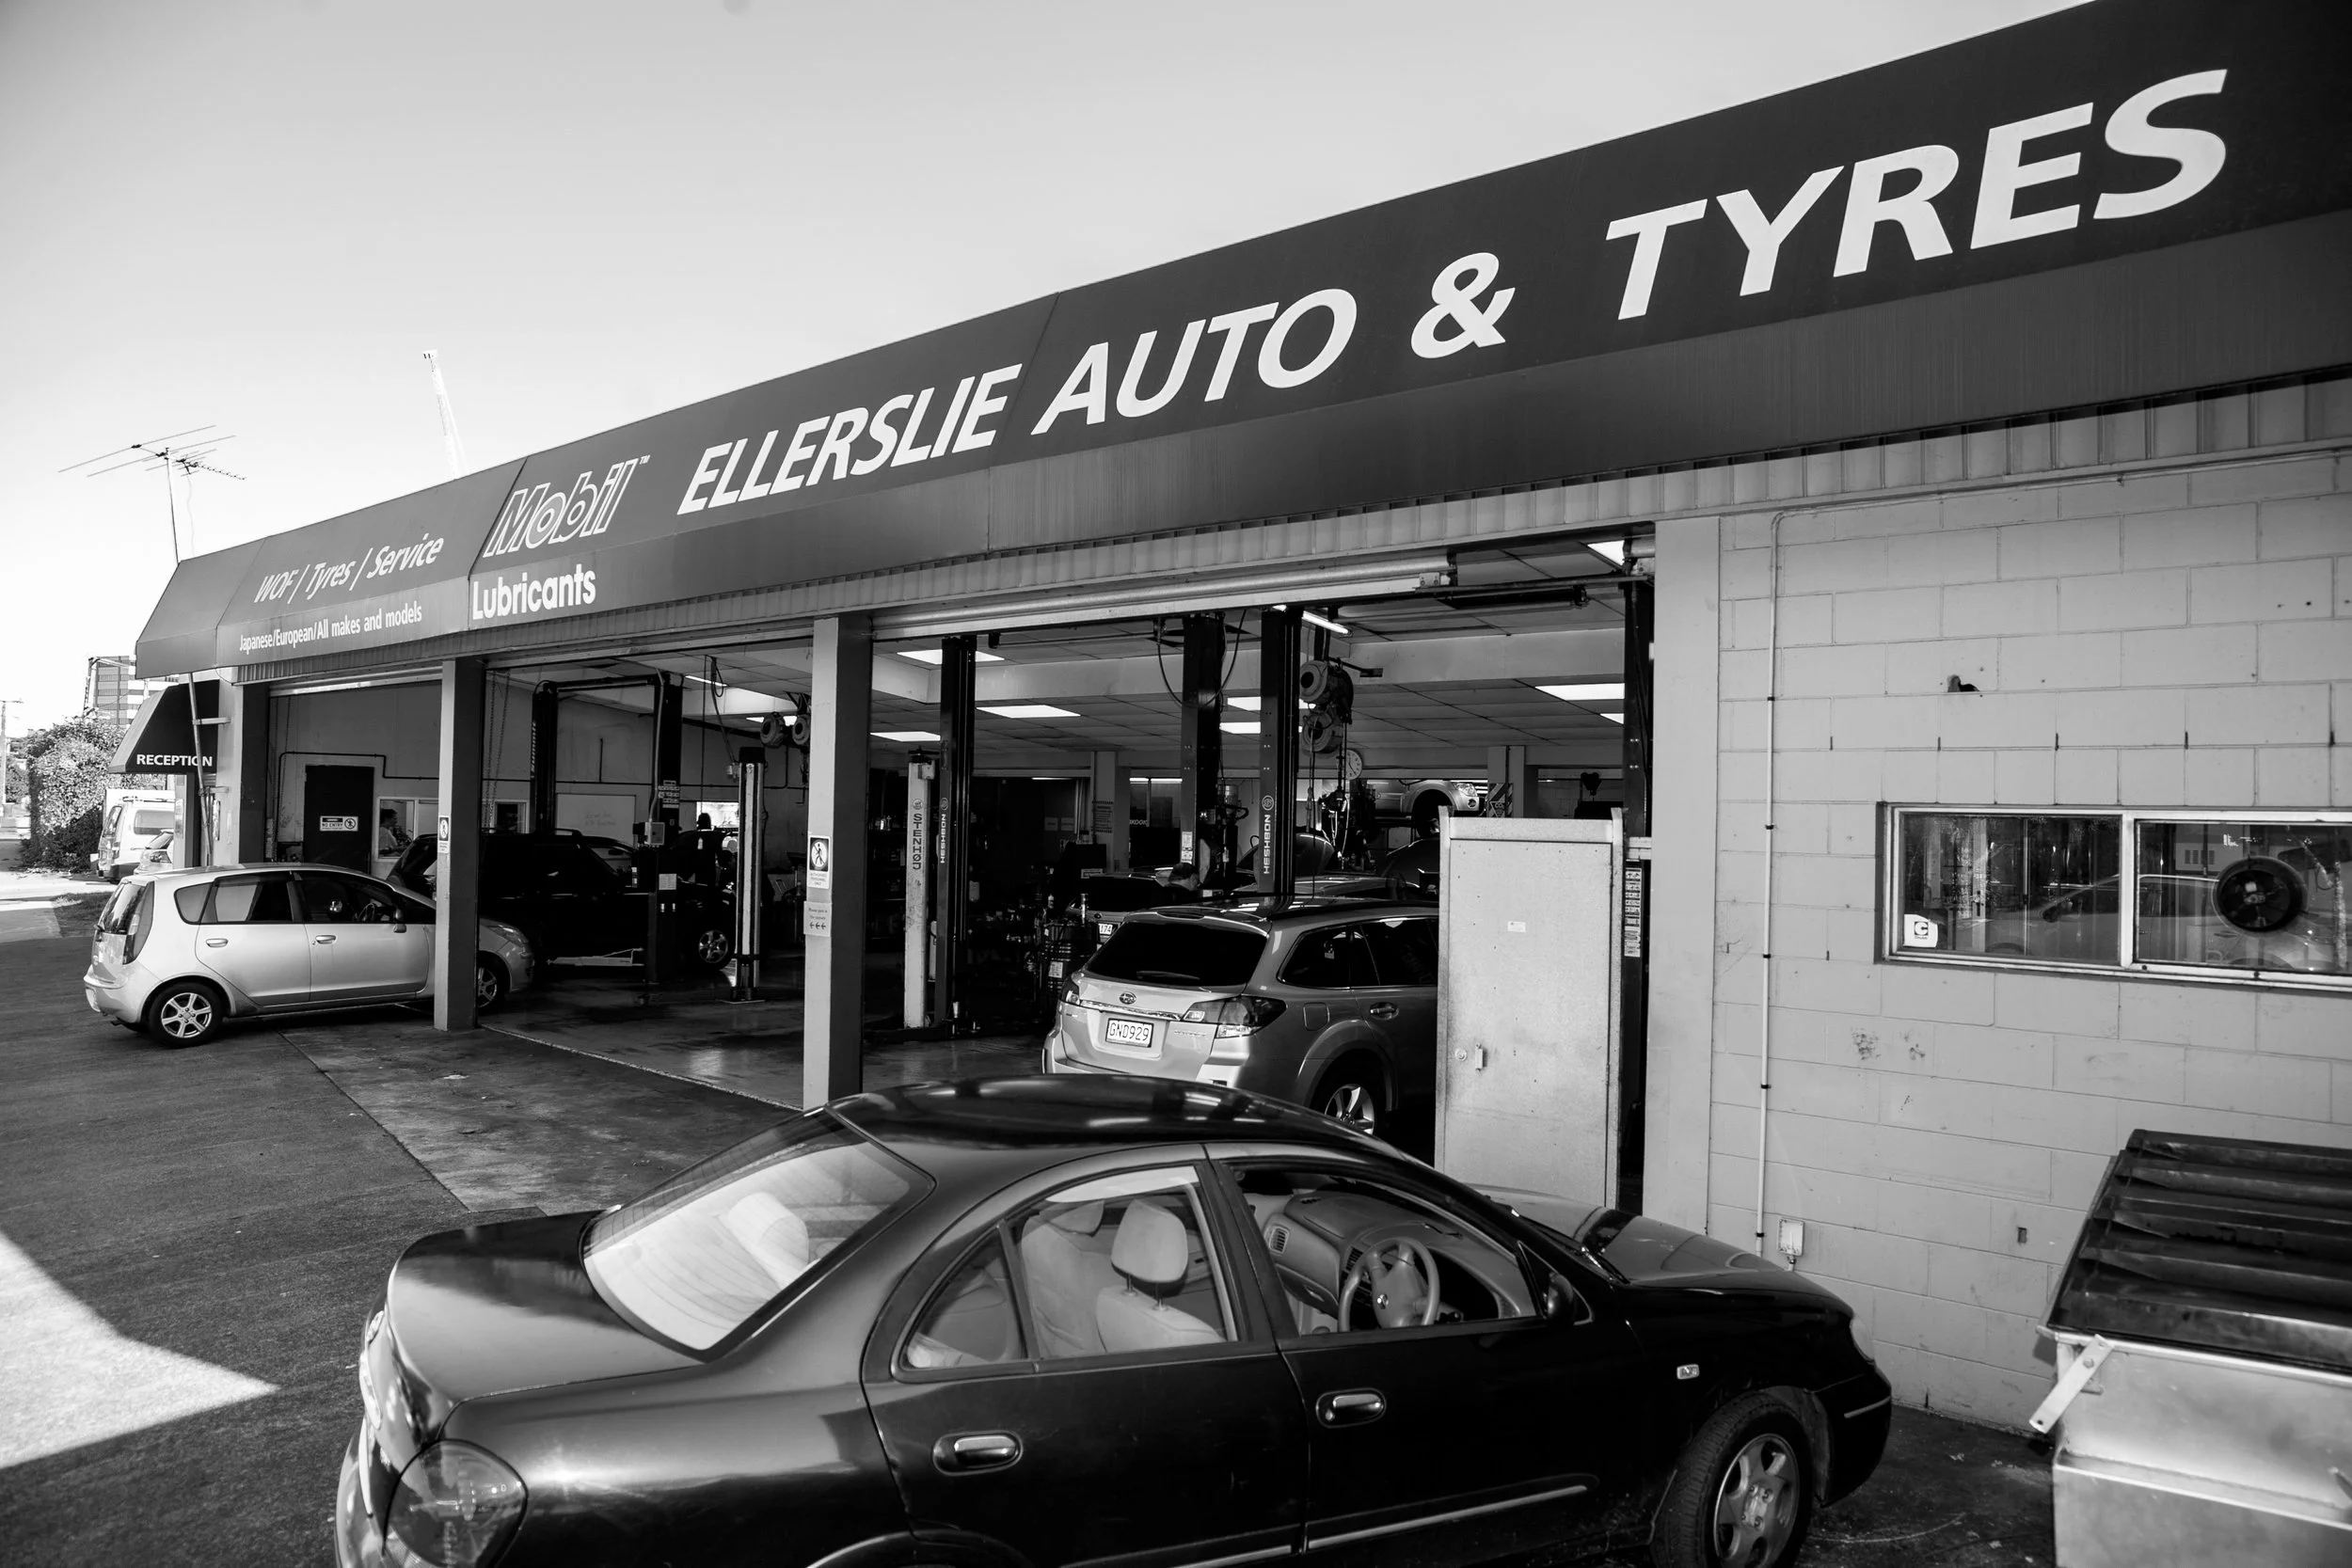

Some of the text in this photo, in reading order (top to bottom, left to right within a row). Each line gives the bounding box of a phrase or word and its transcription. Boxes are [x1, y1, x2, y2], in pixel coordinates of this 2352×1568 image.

[676, 69, 2228, 515] ELLERSLIE AUTO & TYRES
[482, 457, 639, 559] Mobil
[253, 569, 299, 603] WOF
[305, 561, 357, 601] Tyres
[366, 532, 444, 579] Service
[472, 563, 596, 621] Lubricants
[331, 614, 361, 638] makes
[363, 608, 383, 632] and
[385, 600, 422, 628] models
[1263, 814, 1271, 875] HESHBON
[1109, 1022, 1150, 1042] GND929
